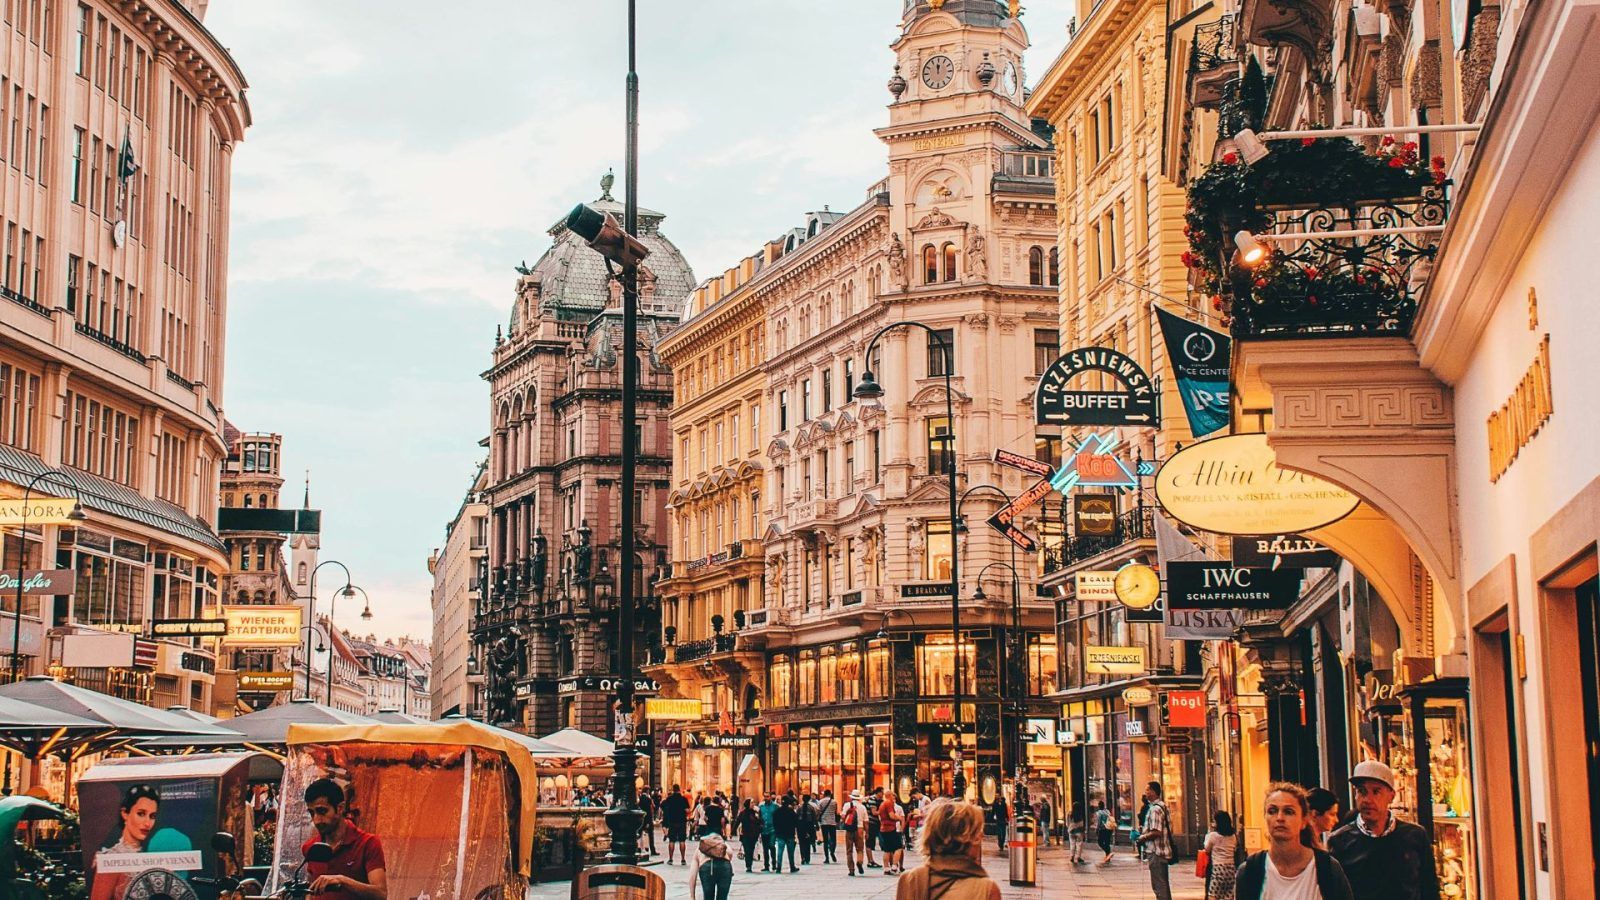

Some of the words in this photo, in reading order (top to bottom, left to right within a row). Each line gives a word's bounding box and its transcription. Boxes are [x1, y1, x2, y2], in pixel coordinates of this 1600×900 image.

[1063, 394, 1129, 409] BUFFET
[1172, 460, 1255, 489] Albin
[1172, 494, 1230, 503] PORZELLAN
[1236, 493, 1283, 502] KRISTALL
[1256, 539, 1318, 553] BALLY
[1202, 568, 1251, 588] IWC
[1186, 592, 1270, 601] SCHAFFHAUSEN
[240, 616, 286, 625] WIENER
[1168, 609, 1240, 628] LISKA
[1171, 695, 1201, 709] högl
[103, 859, 140, 868] IMPERIAL
[142, 857, 164, 867] SHOP
[164, 856, 196, 866] VIENNA
